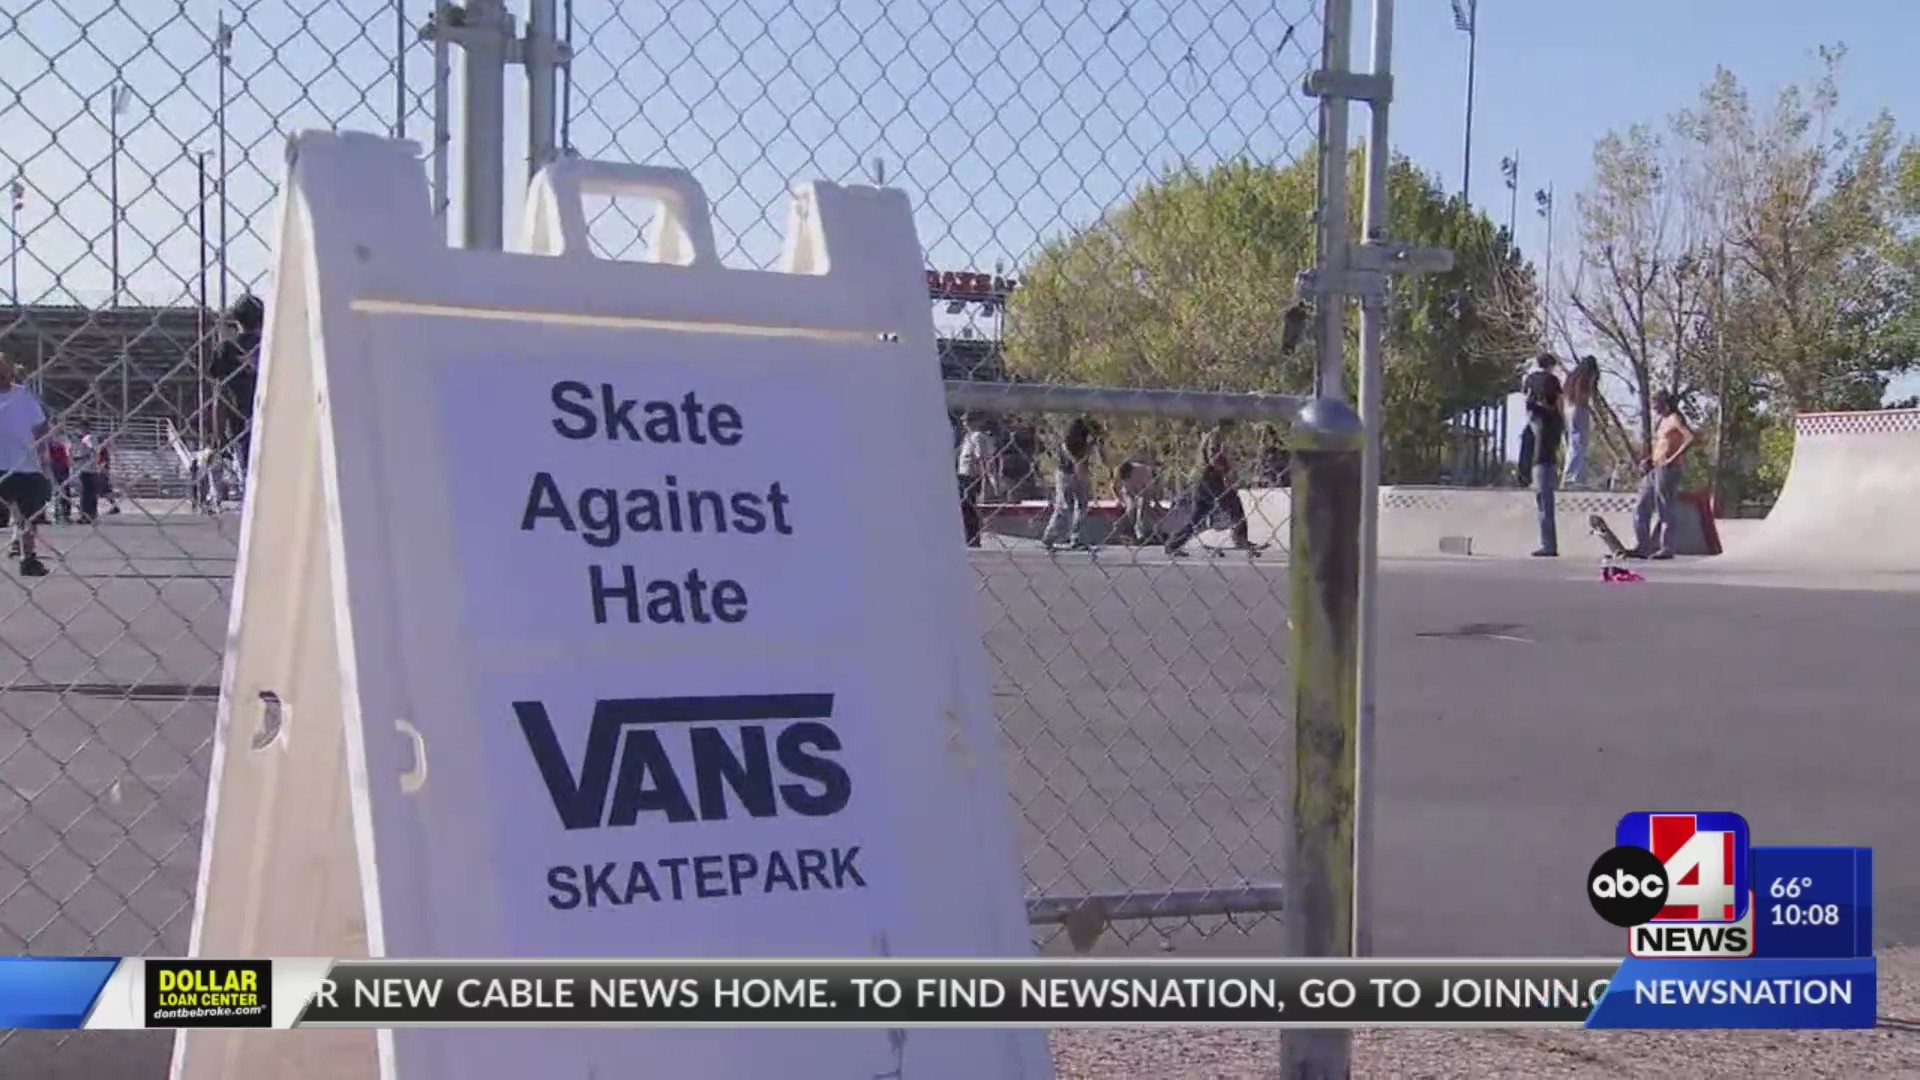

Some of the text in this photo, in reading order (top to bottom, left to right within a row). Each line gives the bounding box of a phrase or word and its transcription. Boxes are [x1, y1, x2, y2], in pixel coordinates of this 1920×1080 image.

[551, 380, 744, 446] Skate
[520, 471, 793, 548] Against
[588, 564, 749, 625] Hate
[511, 692, 852, 831] VANS
[546, 846, 868, 911] SKATEPARK
